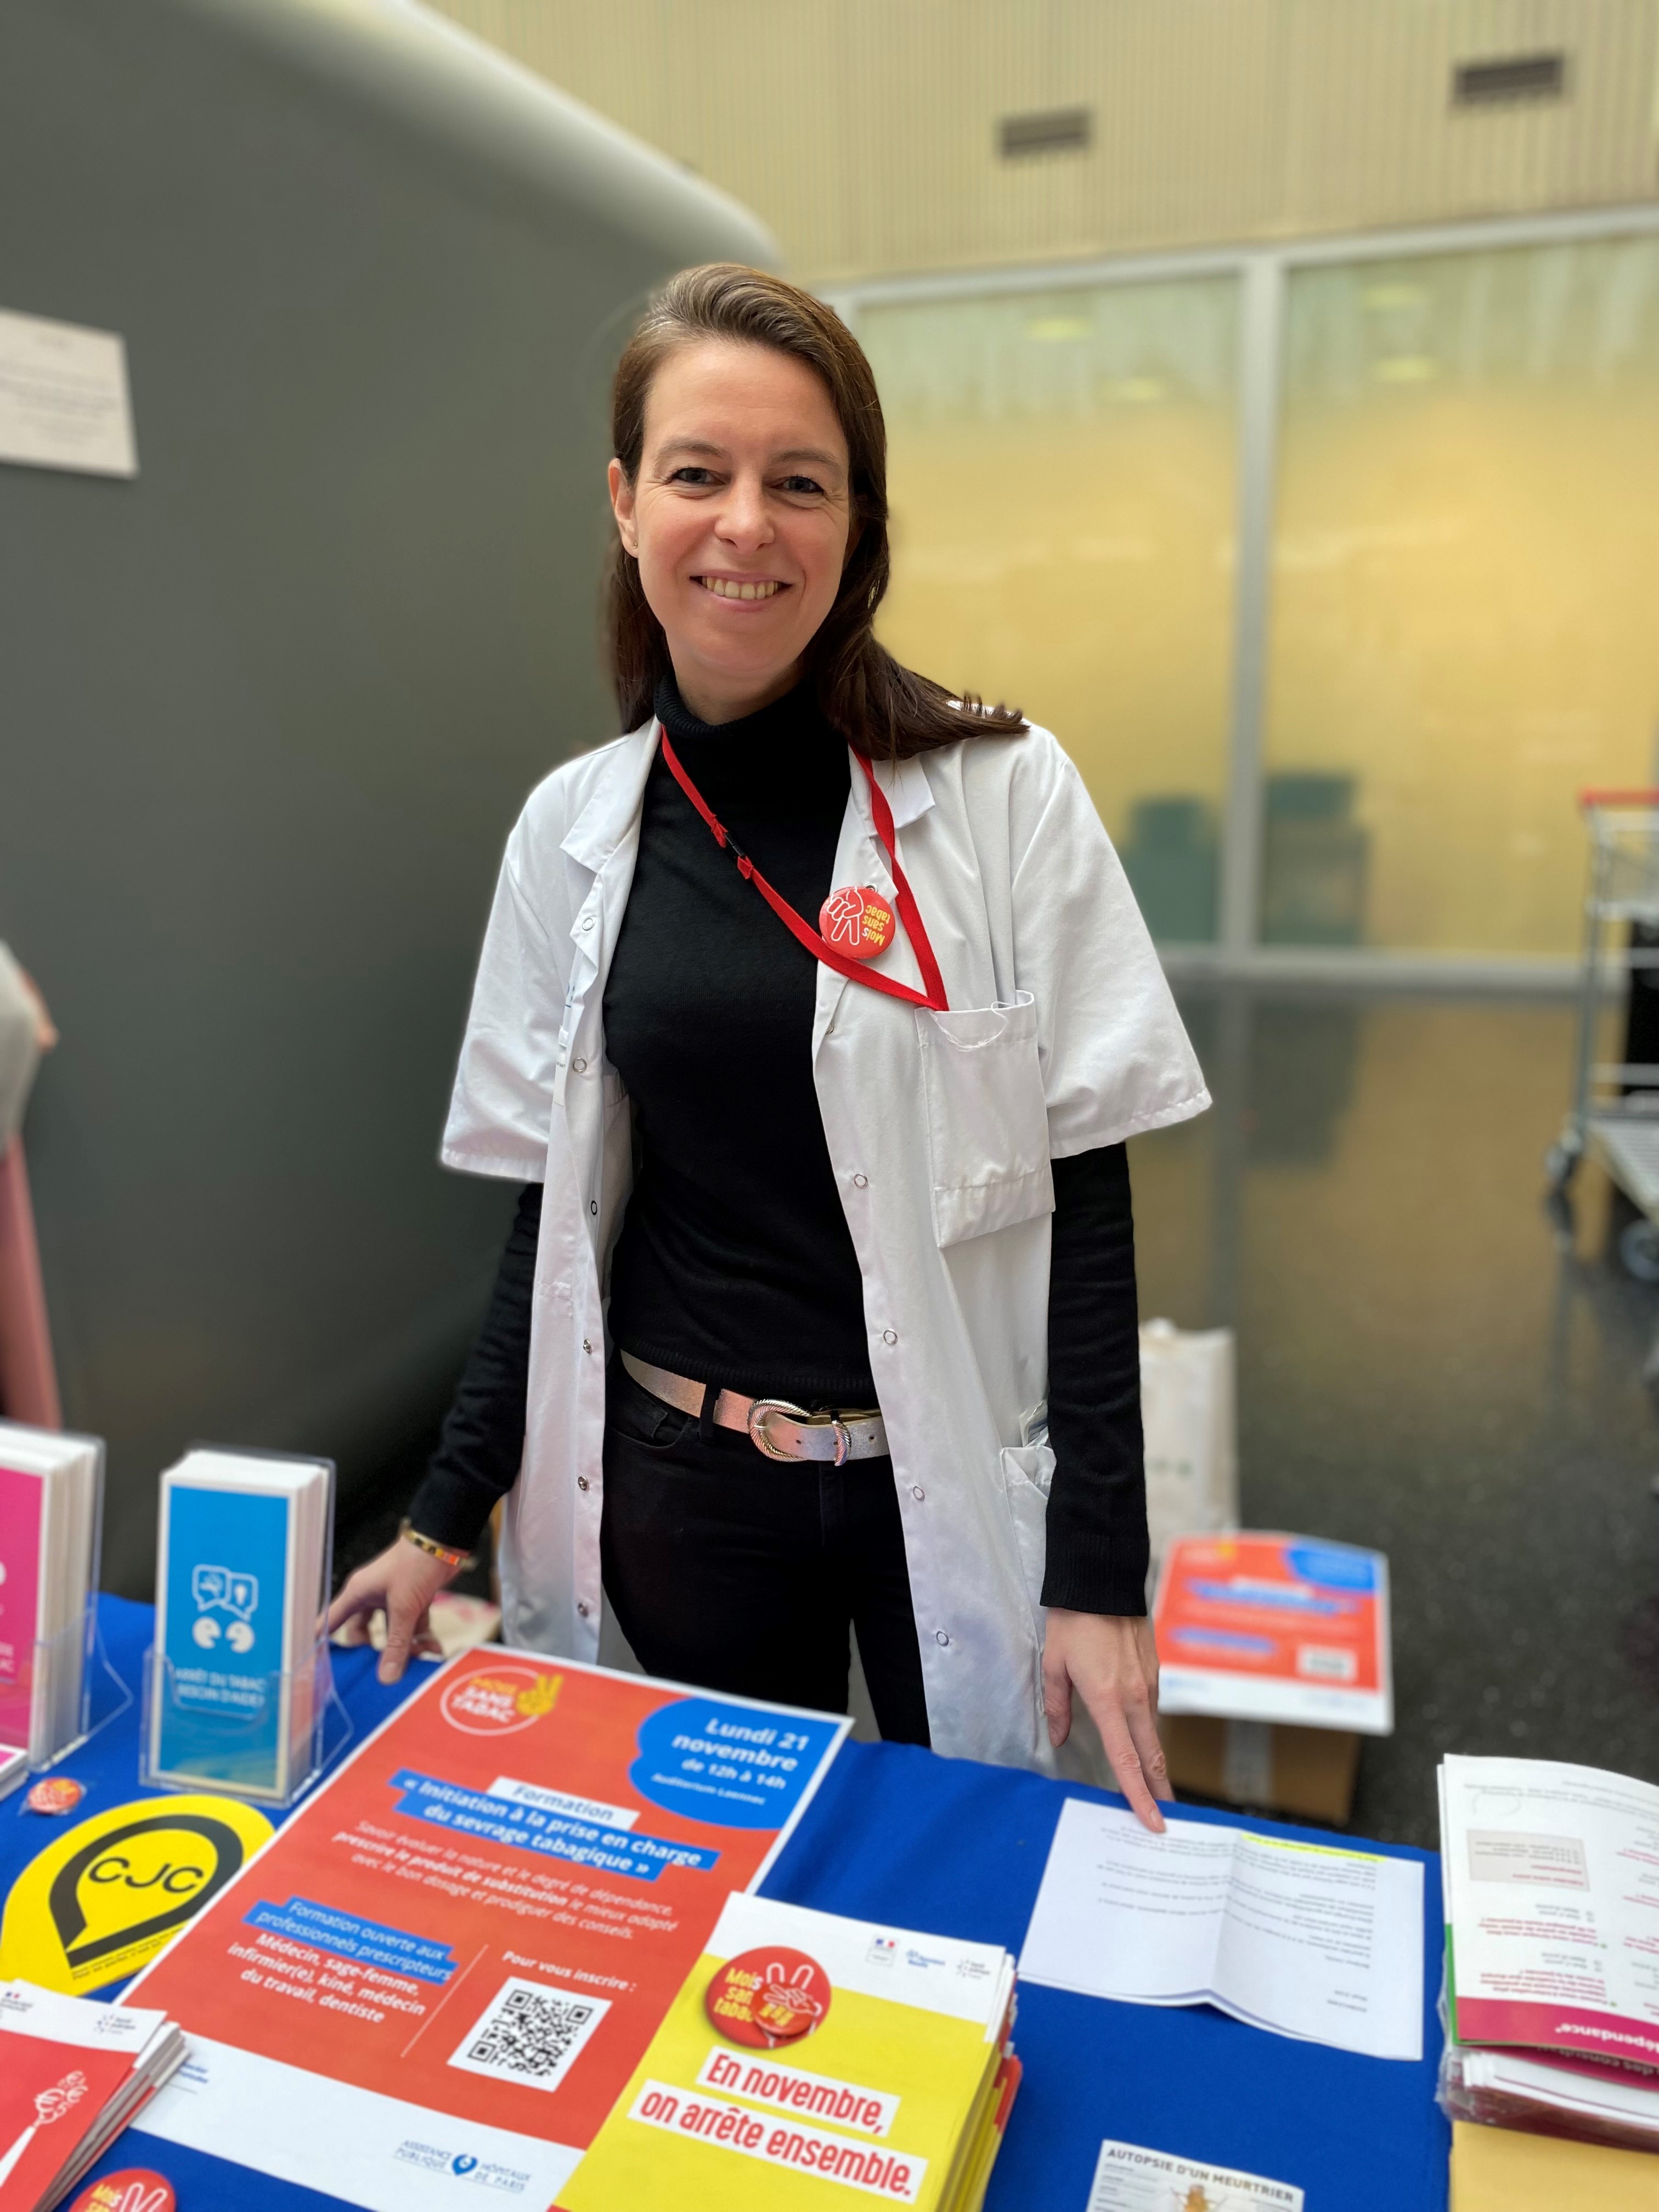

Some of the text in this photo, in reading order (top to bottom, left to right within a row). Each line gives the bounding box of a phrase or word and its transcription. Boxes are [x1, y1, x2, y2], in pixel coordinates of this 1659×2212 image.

[862, 915, 884, 932] sans
[865, 905, 890, 924] tabac
[862, 927, 885, 946] Mois
[671, 1735, 798, 1771] novembre
[705, 1718, 809, 1751] Lundi 21
[681, 1758, 786, 1790] de 12h à 14h
[513, 1785, 614, 1821] Formation
[418, 1781, 508, 1817] Initiation
[509, 1807, 524, 1821] à
[525, 1810, 546, 1827] la
[545, 1819, 599, 1842] prise
[601, 1833, 629, 1848] en
[630, 1840, 702, 1866] charge
[424, 1804, 452, 1821] du
[452, 1814, 529, 1844] sevrage
[531, 1833, 633, 1870] tabagique
[88, 1857, 204, 1894] CJC
[394, 1848, 411, 1861] le
[407, 1855, 464, 1877] produit
[461, 1870, 482, 1883] de
[481, 1877, 568, 1906] substitution
[255, 1911, 455, 1981] professionnels prescripteurs
[289, 1901, 445, 1960] Formation ouverte aux
[227, 1942, 427, 2017] infirmier(e), kiné, médecin
[255, 1932, 420, 1996] Médecin, sage-femme,
[501, 1950, 537, 1968] Pour
[538, 1961, 573, 1978] vous
[573, 1969, 629, 1990] inscrire
[725, 1967, 764, 1990] Mois
[240, 1968, 385, 2023] du travail, dentiste
[725, 1985, 754, 2005] san
[707, 2053, 883, 2134] En novembre,
[640, 2092, 912, 2196] on arrête ensemble.
[495, 2176, 526, 2192] PARIS
[1107, 2148, 1173, 2172] AUTOPSIE
[1176, 2165, 1210, 2182] D'UN
[1212, 2174, 1294, 2203] MEURTRIER
